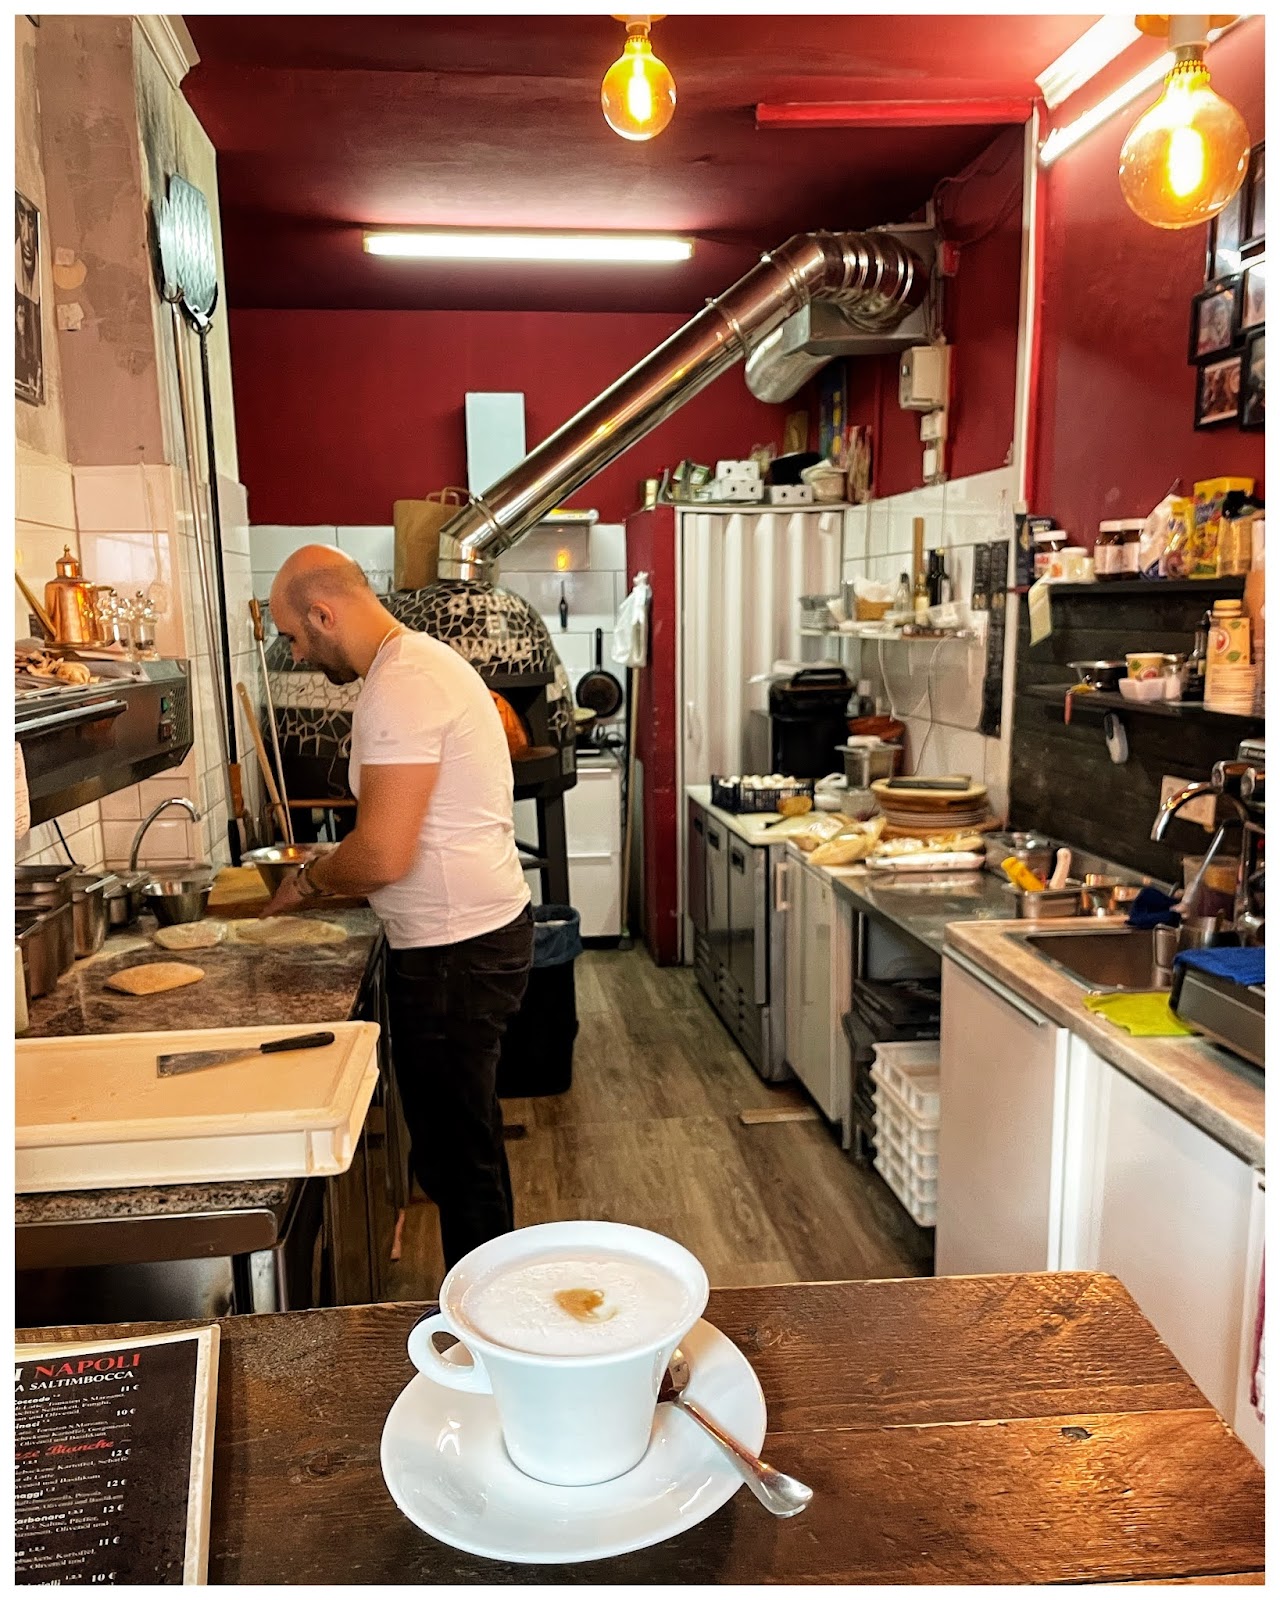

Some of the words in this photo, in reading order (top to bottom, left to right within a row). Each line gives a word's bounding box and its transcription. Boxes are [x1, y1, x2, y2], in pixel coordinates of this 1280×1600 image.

[33, 1353, 140, 1379] NAPOLI
[29, 1370, 134, 1391] SALTIMBOCCA
[111, 1449, 123, 1457] 12
[124, 1448, 132, 1456] €
[106, 1480, 119, 1488] 12
[103, 1505, 115, 1513] 12
[116, 1503, 125, 1511] €
[98, 1538, 110, 1547] 11
[112, 1536, 121, 1545] €
[91, 1573, 106, 1583] 10
[108, 1571, 118, 1580] €
